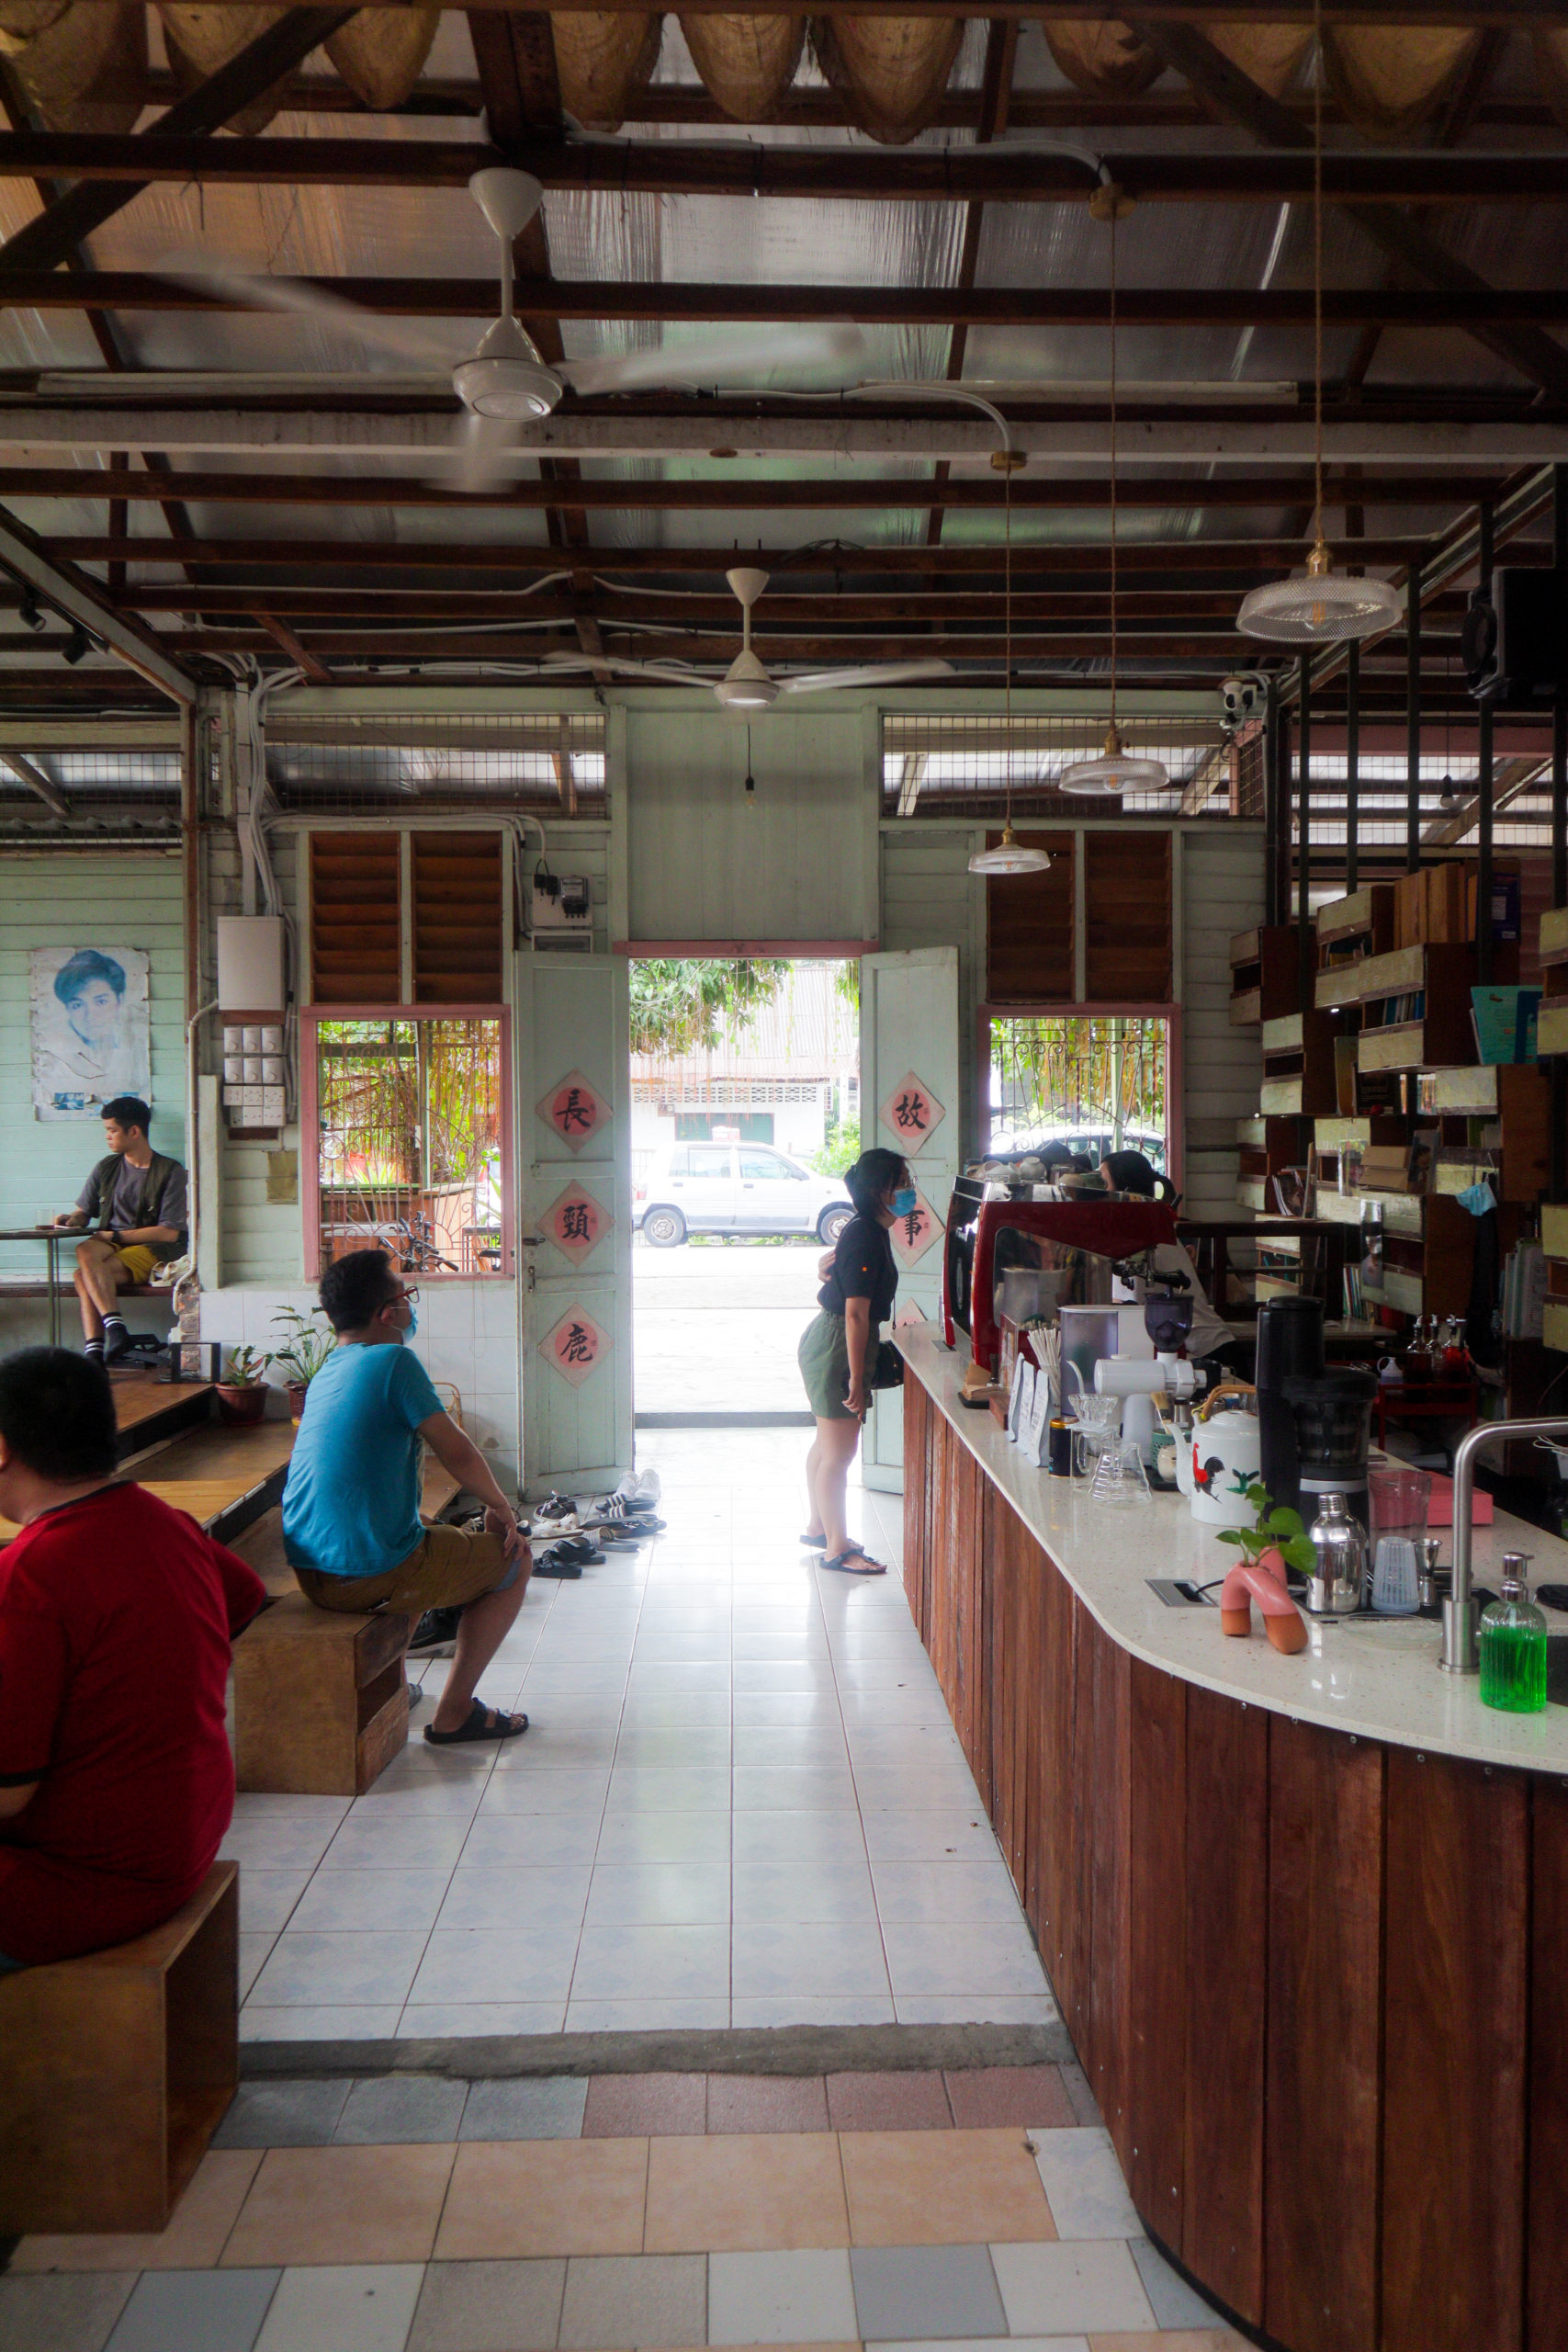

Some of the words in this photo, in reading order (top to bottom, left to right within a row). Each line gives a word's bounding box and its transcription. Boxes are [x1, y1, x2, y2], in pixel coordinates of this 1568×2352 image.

[556, 1089, 591, 1132] 長
[895, 1092, 926, 1129] 故
[902, 1209, 925, 1248] 事
[559, 1323, 593, 1363] 鹿
